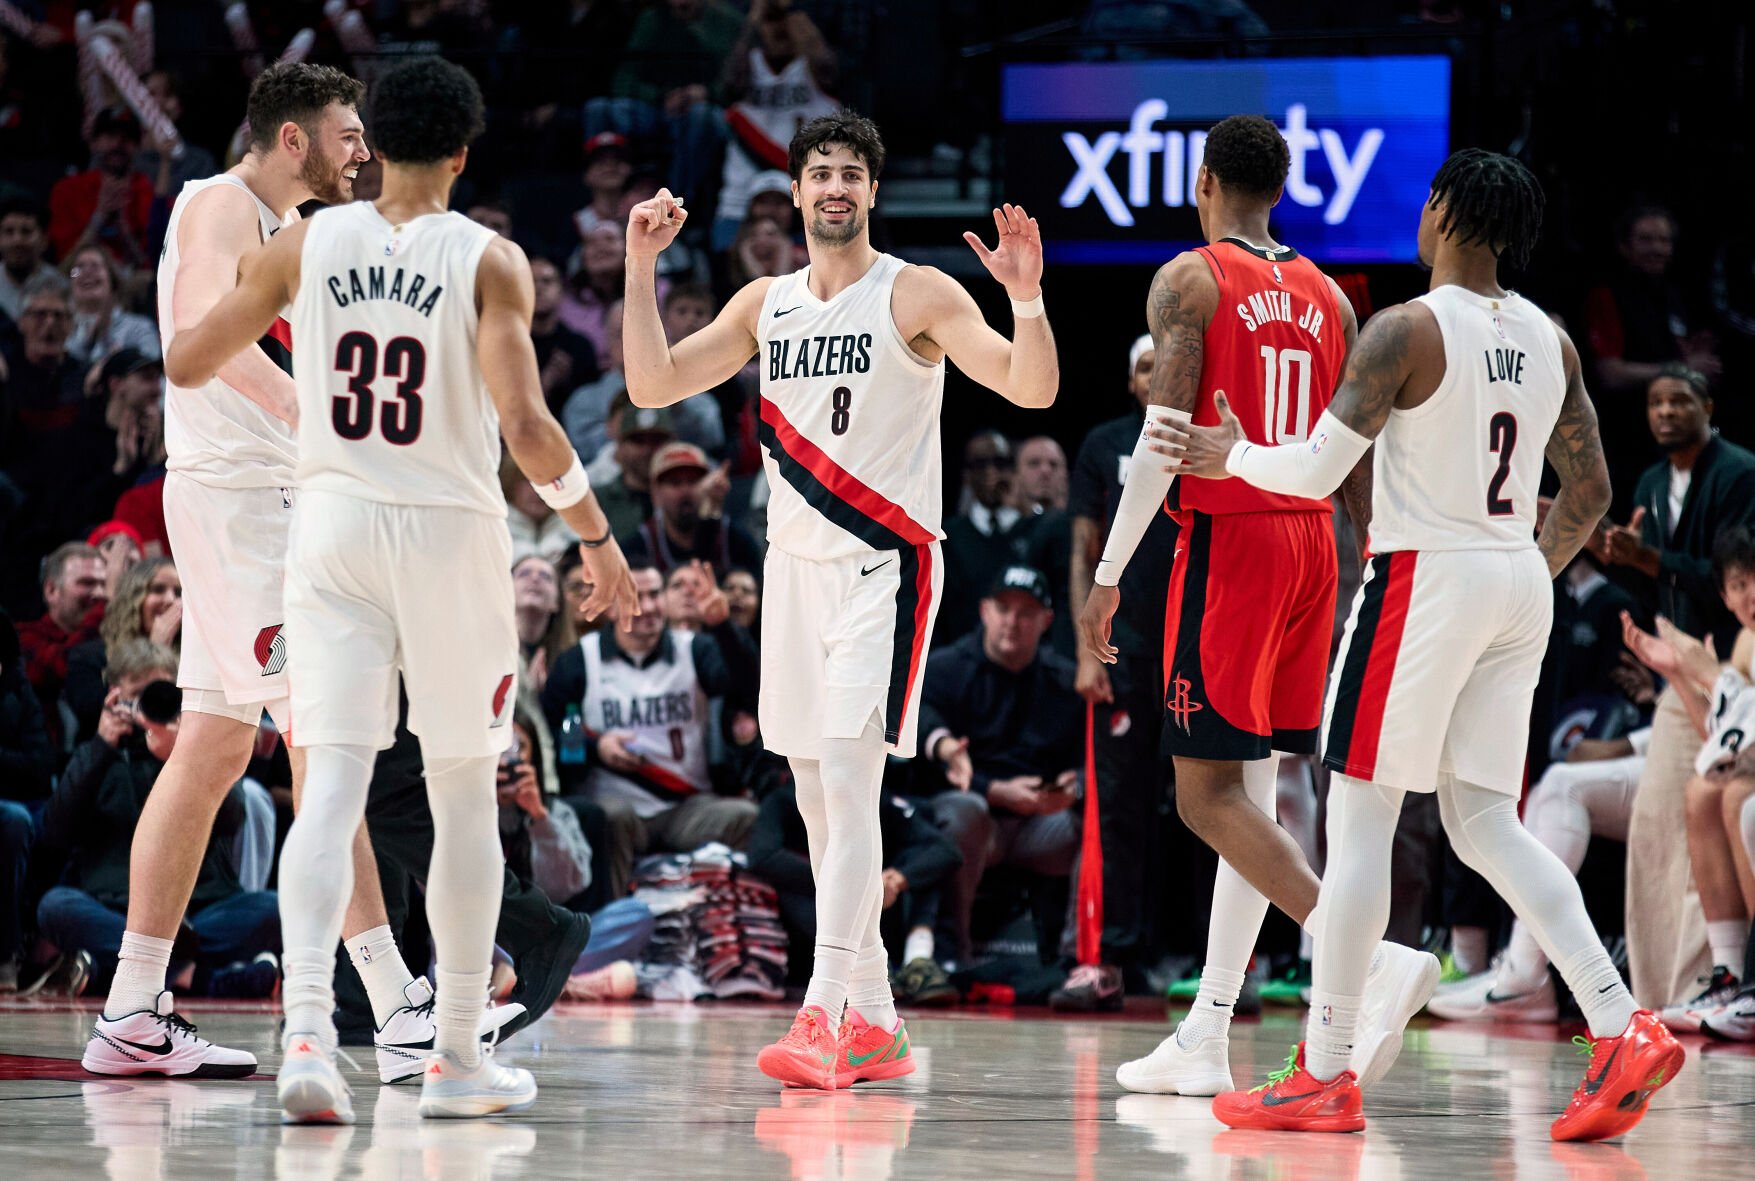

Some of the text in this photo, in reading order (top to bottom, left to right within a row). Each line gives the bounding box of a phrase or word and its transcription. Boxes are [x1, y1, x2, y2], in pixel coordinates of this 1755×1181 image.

[1059, 98, 1385, 227] xfity
[327, 265, 443, 318] CAMARA
[1236, 290, 1324, 344] SMITH JR.
[767, 332, 873, 382] BLAZERS
[1485, 348, 1526, 385] LOVE
[331, 330, 427, 447] 33
[831, 386, 853, 436] 8
[1260, 345, 1312, 445] 10
[1487, 411, 1518, 517] 2
[602, 690, 693, 730] BLAZERS
